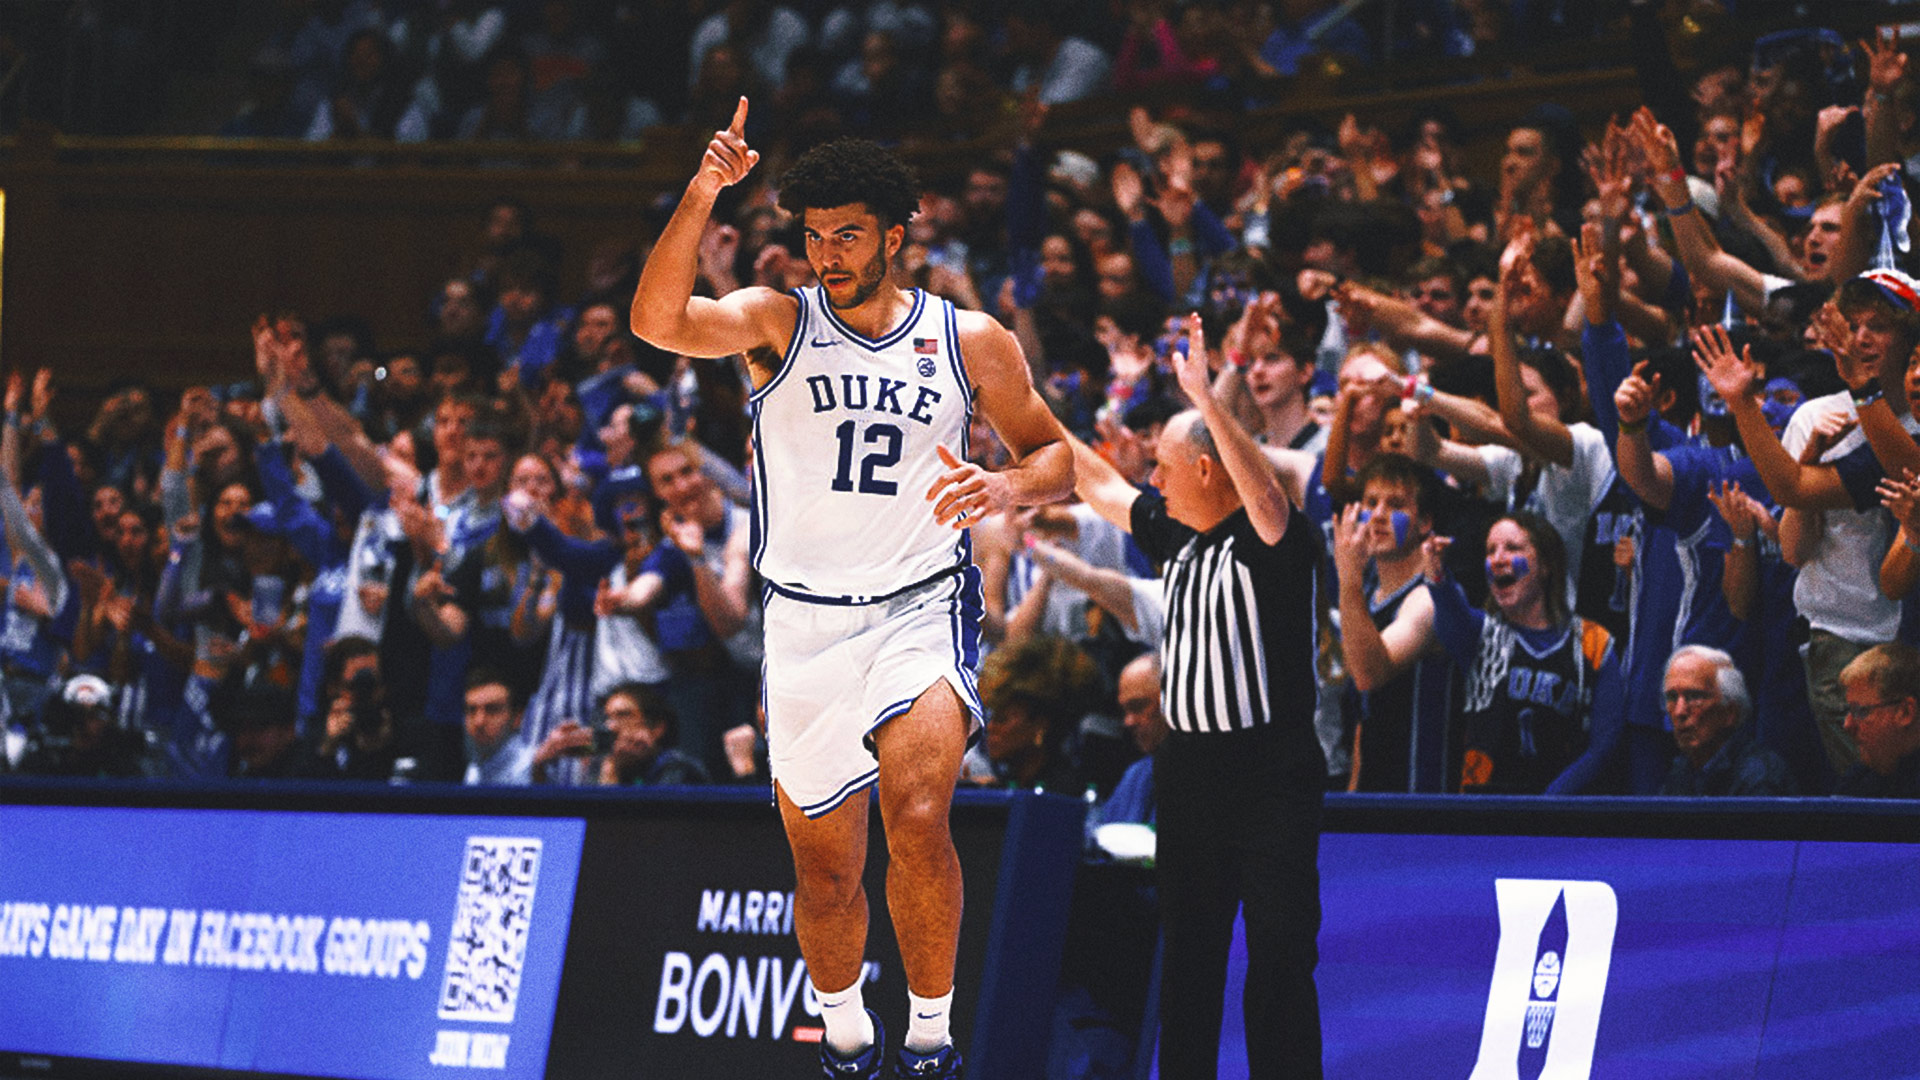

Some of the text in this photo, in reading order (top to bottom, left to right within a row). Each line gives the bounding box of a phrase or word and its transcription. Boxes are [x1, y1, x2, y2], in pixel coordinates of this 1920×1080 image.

[806, 375, 942, 425] DUKE
[831, 420, 904, 496] 12
[49, 903, 118, 962] GAME
[114, 906, 168, 965] DAY
[194, 910, 326, 973] FACEBOOK
[322, 916, 431, 980] GROUPS
[697, 888, 795, 935] MARRI
